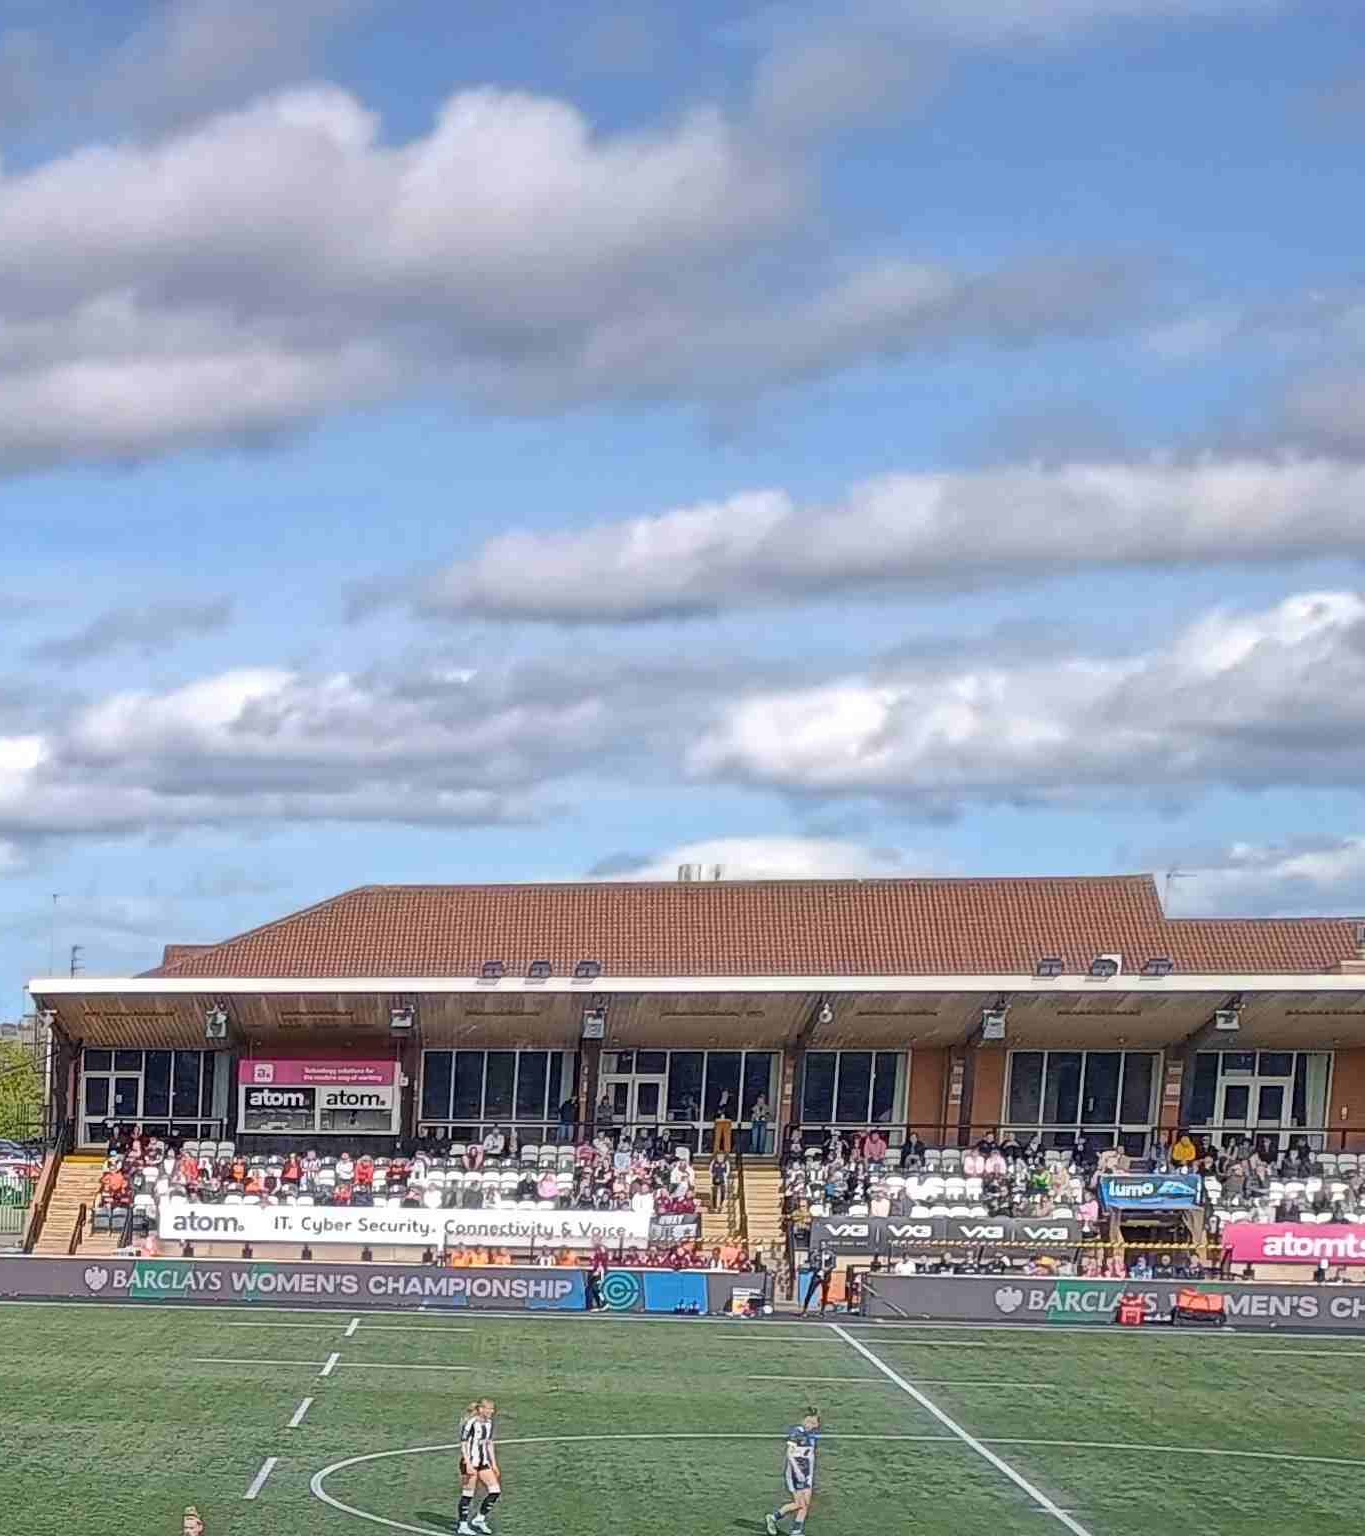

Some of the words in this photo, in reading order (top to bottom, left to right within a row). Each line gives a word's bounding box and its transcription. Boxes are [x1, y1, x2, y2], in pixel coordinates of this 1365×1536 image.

[1109, 1180, 1154, 1197] lumo
[301, 1216, 352, 1235] Cyber
[444, 1219, 554, 1239] Connectivity
[112, 1269, 222, 1292] BARCLAYS
[231, 1271, 359, 1295] WOMEN'S
[368, 1274, 573, 1300] CHAMPIONSHIP
[1028, 1289, 1158, 1314] BARCLAS
[1169, 1293, 1319, 1318] MEN'S
